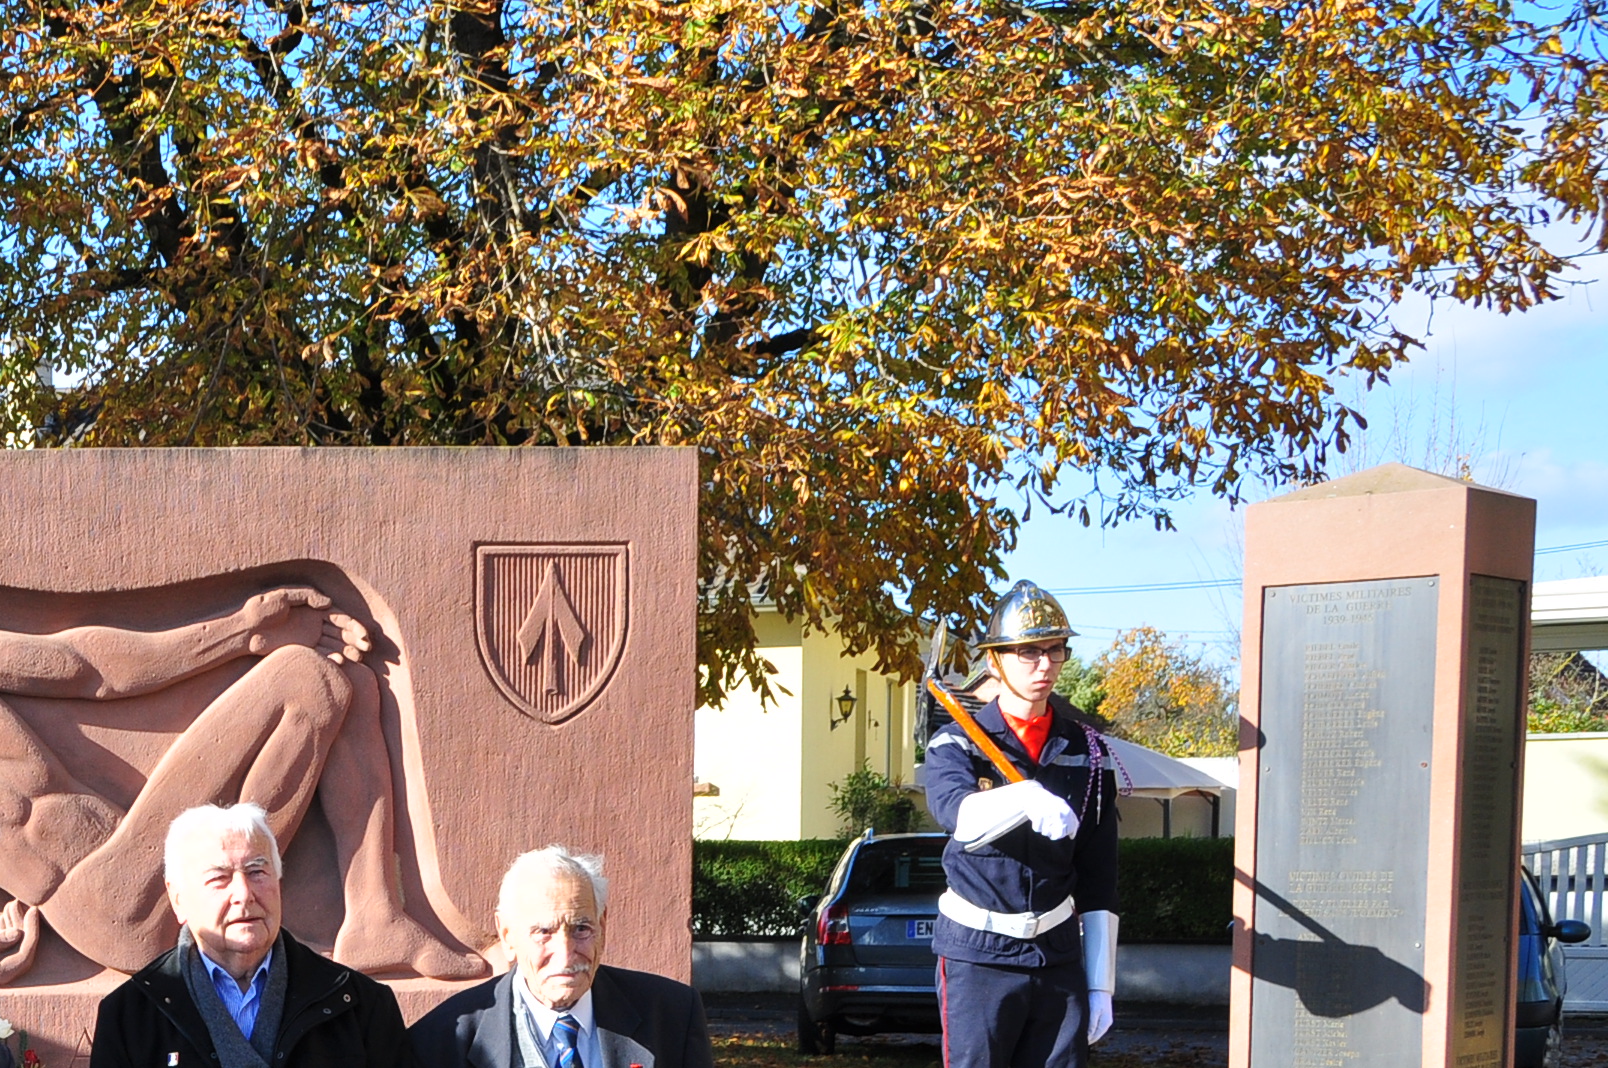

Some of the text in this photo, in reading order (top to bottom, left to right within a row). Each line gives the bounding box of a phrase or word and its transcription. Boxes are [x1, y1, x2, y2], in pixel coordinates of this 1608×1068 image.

[1290, 586, 1412, 604] VICTIMES MILITAIRES
[1306, 600, 1392, 614] DE LA GUERRE
[1288, 870, 1336, 882] VICTIMES
[1380, 870, 1395, 882] DE
